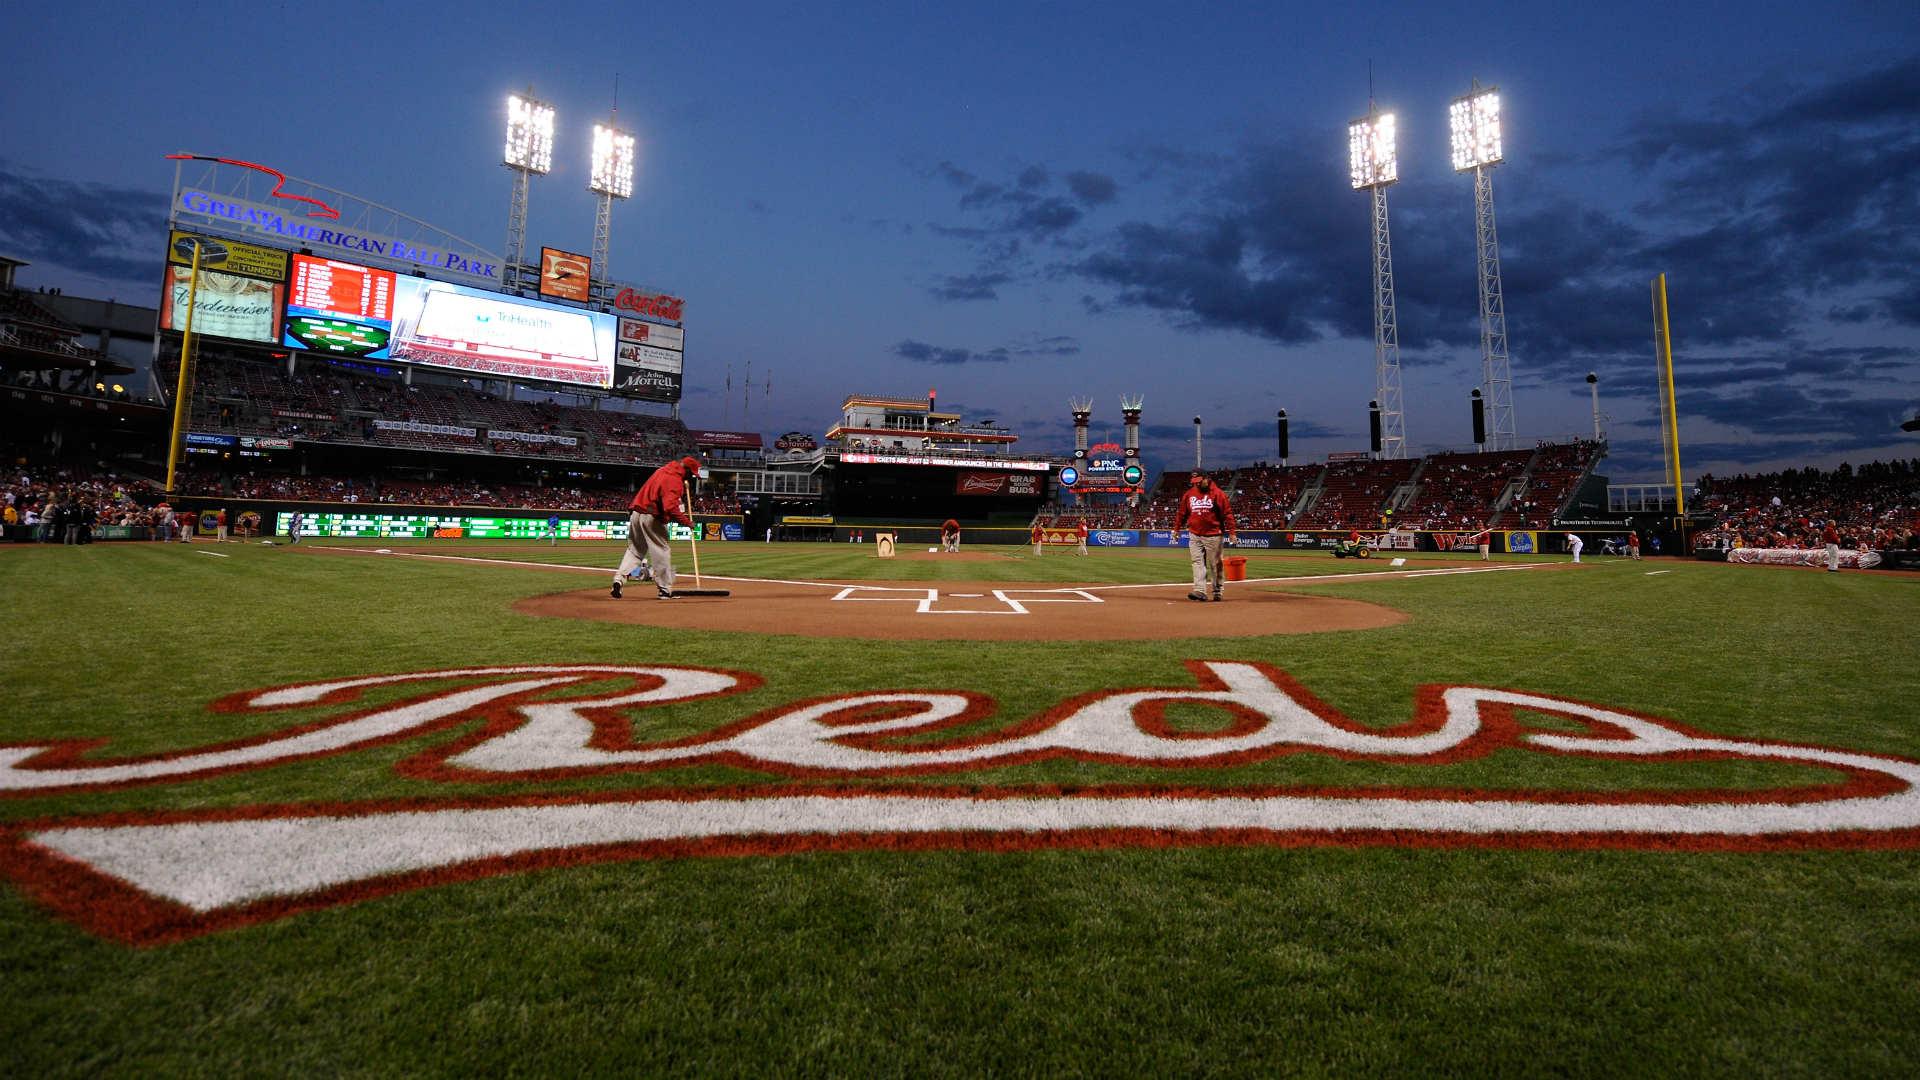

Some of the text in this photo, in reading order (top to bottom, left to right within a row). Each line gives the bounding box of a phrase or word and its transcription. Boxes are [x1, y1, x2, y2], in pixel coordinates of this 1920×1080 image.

[183, 191, 497, 279] GREAT AMERICAN BALL PARK
[240, 264, 281, 277] TUNDRA
[615, 288, 684, 321] Coca-Cola
[646, 371, 667, 382] John
[617, 374, 680, 391] Morrell
[873, 455, 895, 464] TICKETS
[909, 457, 921, 465] JUST
[1101, 459, 1119, 468] PNC
[1009, 475, 1035, 483] GRAB
[1009, 486, 1035, 494] BUDS
[1190, 495, 1213, 507] Reds
